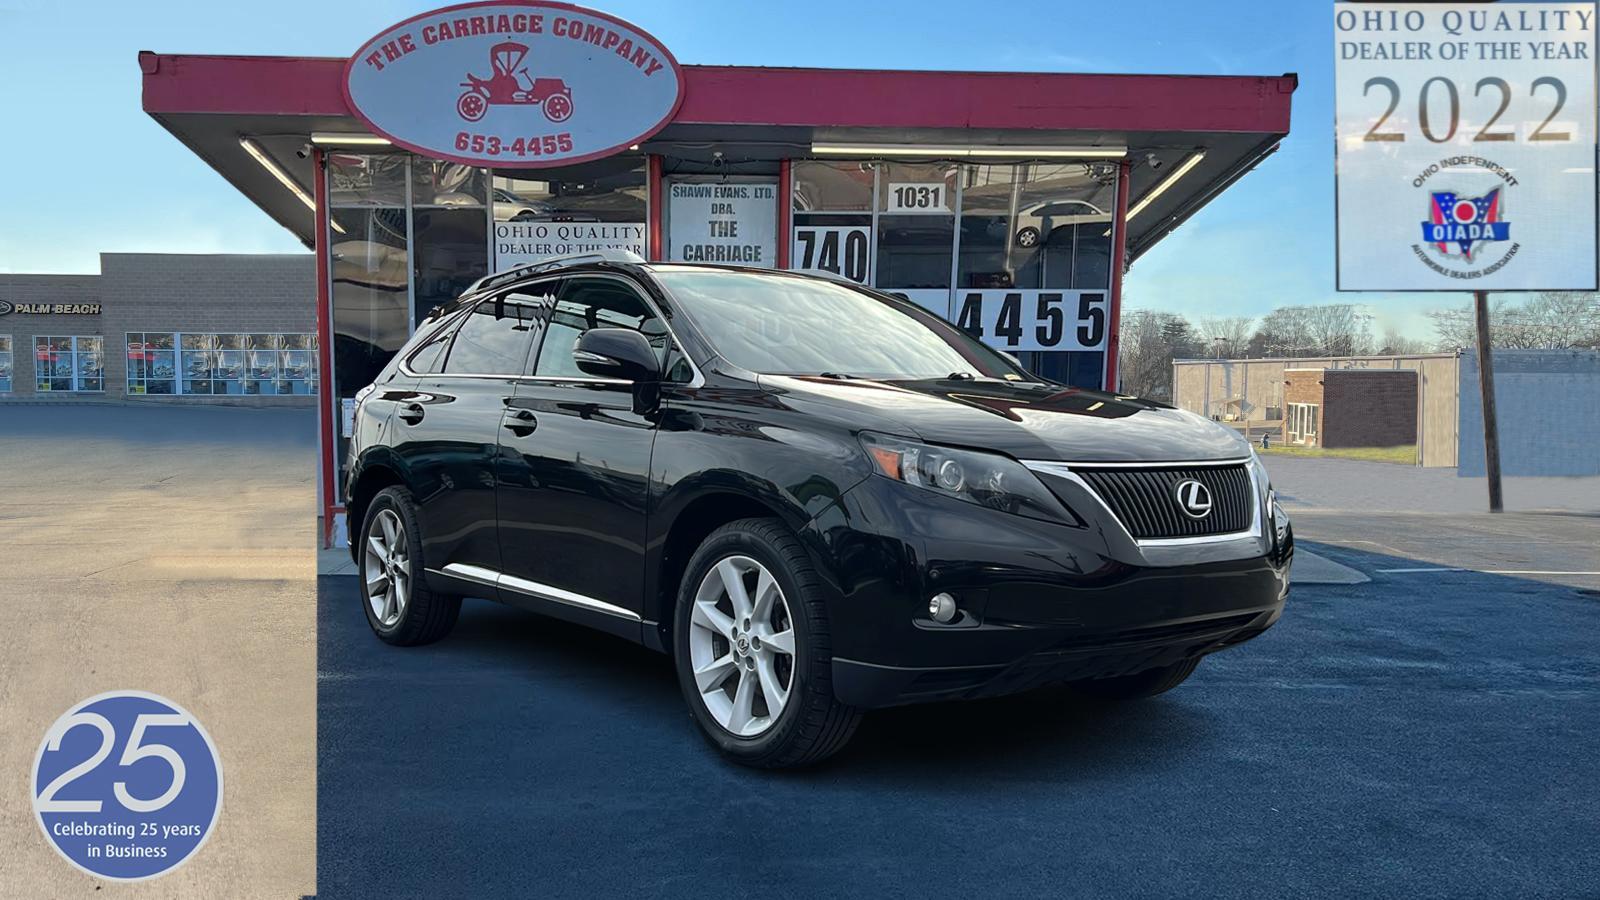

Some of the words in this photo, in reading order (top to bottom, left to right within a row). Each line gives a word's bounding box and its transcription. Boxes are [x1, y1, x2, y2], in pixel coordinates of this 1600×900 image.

[1336, 10, 1425, 31] OHIO
[1442, 10, 1593, 36] QUALITY
[365, 33, 417, 72] THE
[421, 14, 544, 45] CARRIAGE
[553, 17, 664, 77] COMPANY
[1340, 41, 1433, 60] DEALER
[1438, 41, 1470, 60] OF
[1474, 41, 1522, 60] THE
[1527, 41, 1589, 60] YEAR
[1363, 76, 1571, 143] 2022
[455, 131, 573, 157] 653-4455
[1412, 163, 1439, 188] OHIO
[1439, 155, 1519, 187] INDEPENDENT
[672, 186, 712, 198] SHAWN
[754, 187, 775, 199] LTD.
[894, 186, 941, 208] 1031
[711, 203, 736, 215] DBA.
[497, 226, 548, 239] OHIO
[557, 226, 643, 241] QUALITY
[708, 220, 738, 237] THE
[1432, 224, 1495, 241] OIADA
[499, 243, 552, 255] DEALER
[555, 243, 576, 254] OF
[683, 244, 762, 262] CARRIAGE
[797, 229, 868, 284] 740
[1411, 243, 1449, 277] AUTOMOBILE
[1450, 269, 1482, 280] DEALERS
[1482, 242, 1521, 276] ASSOCIATION
[14, 303, 51, 314] PALM
[54, 304, 100, 314] BEACH
[957, 292, 1105, 348] 4455
